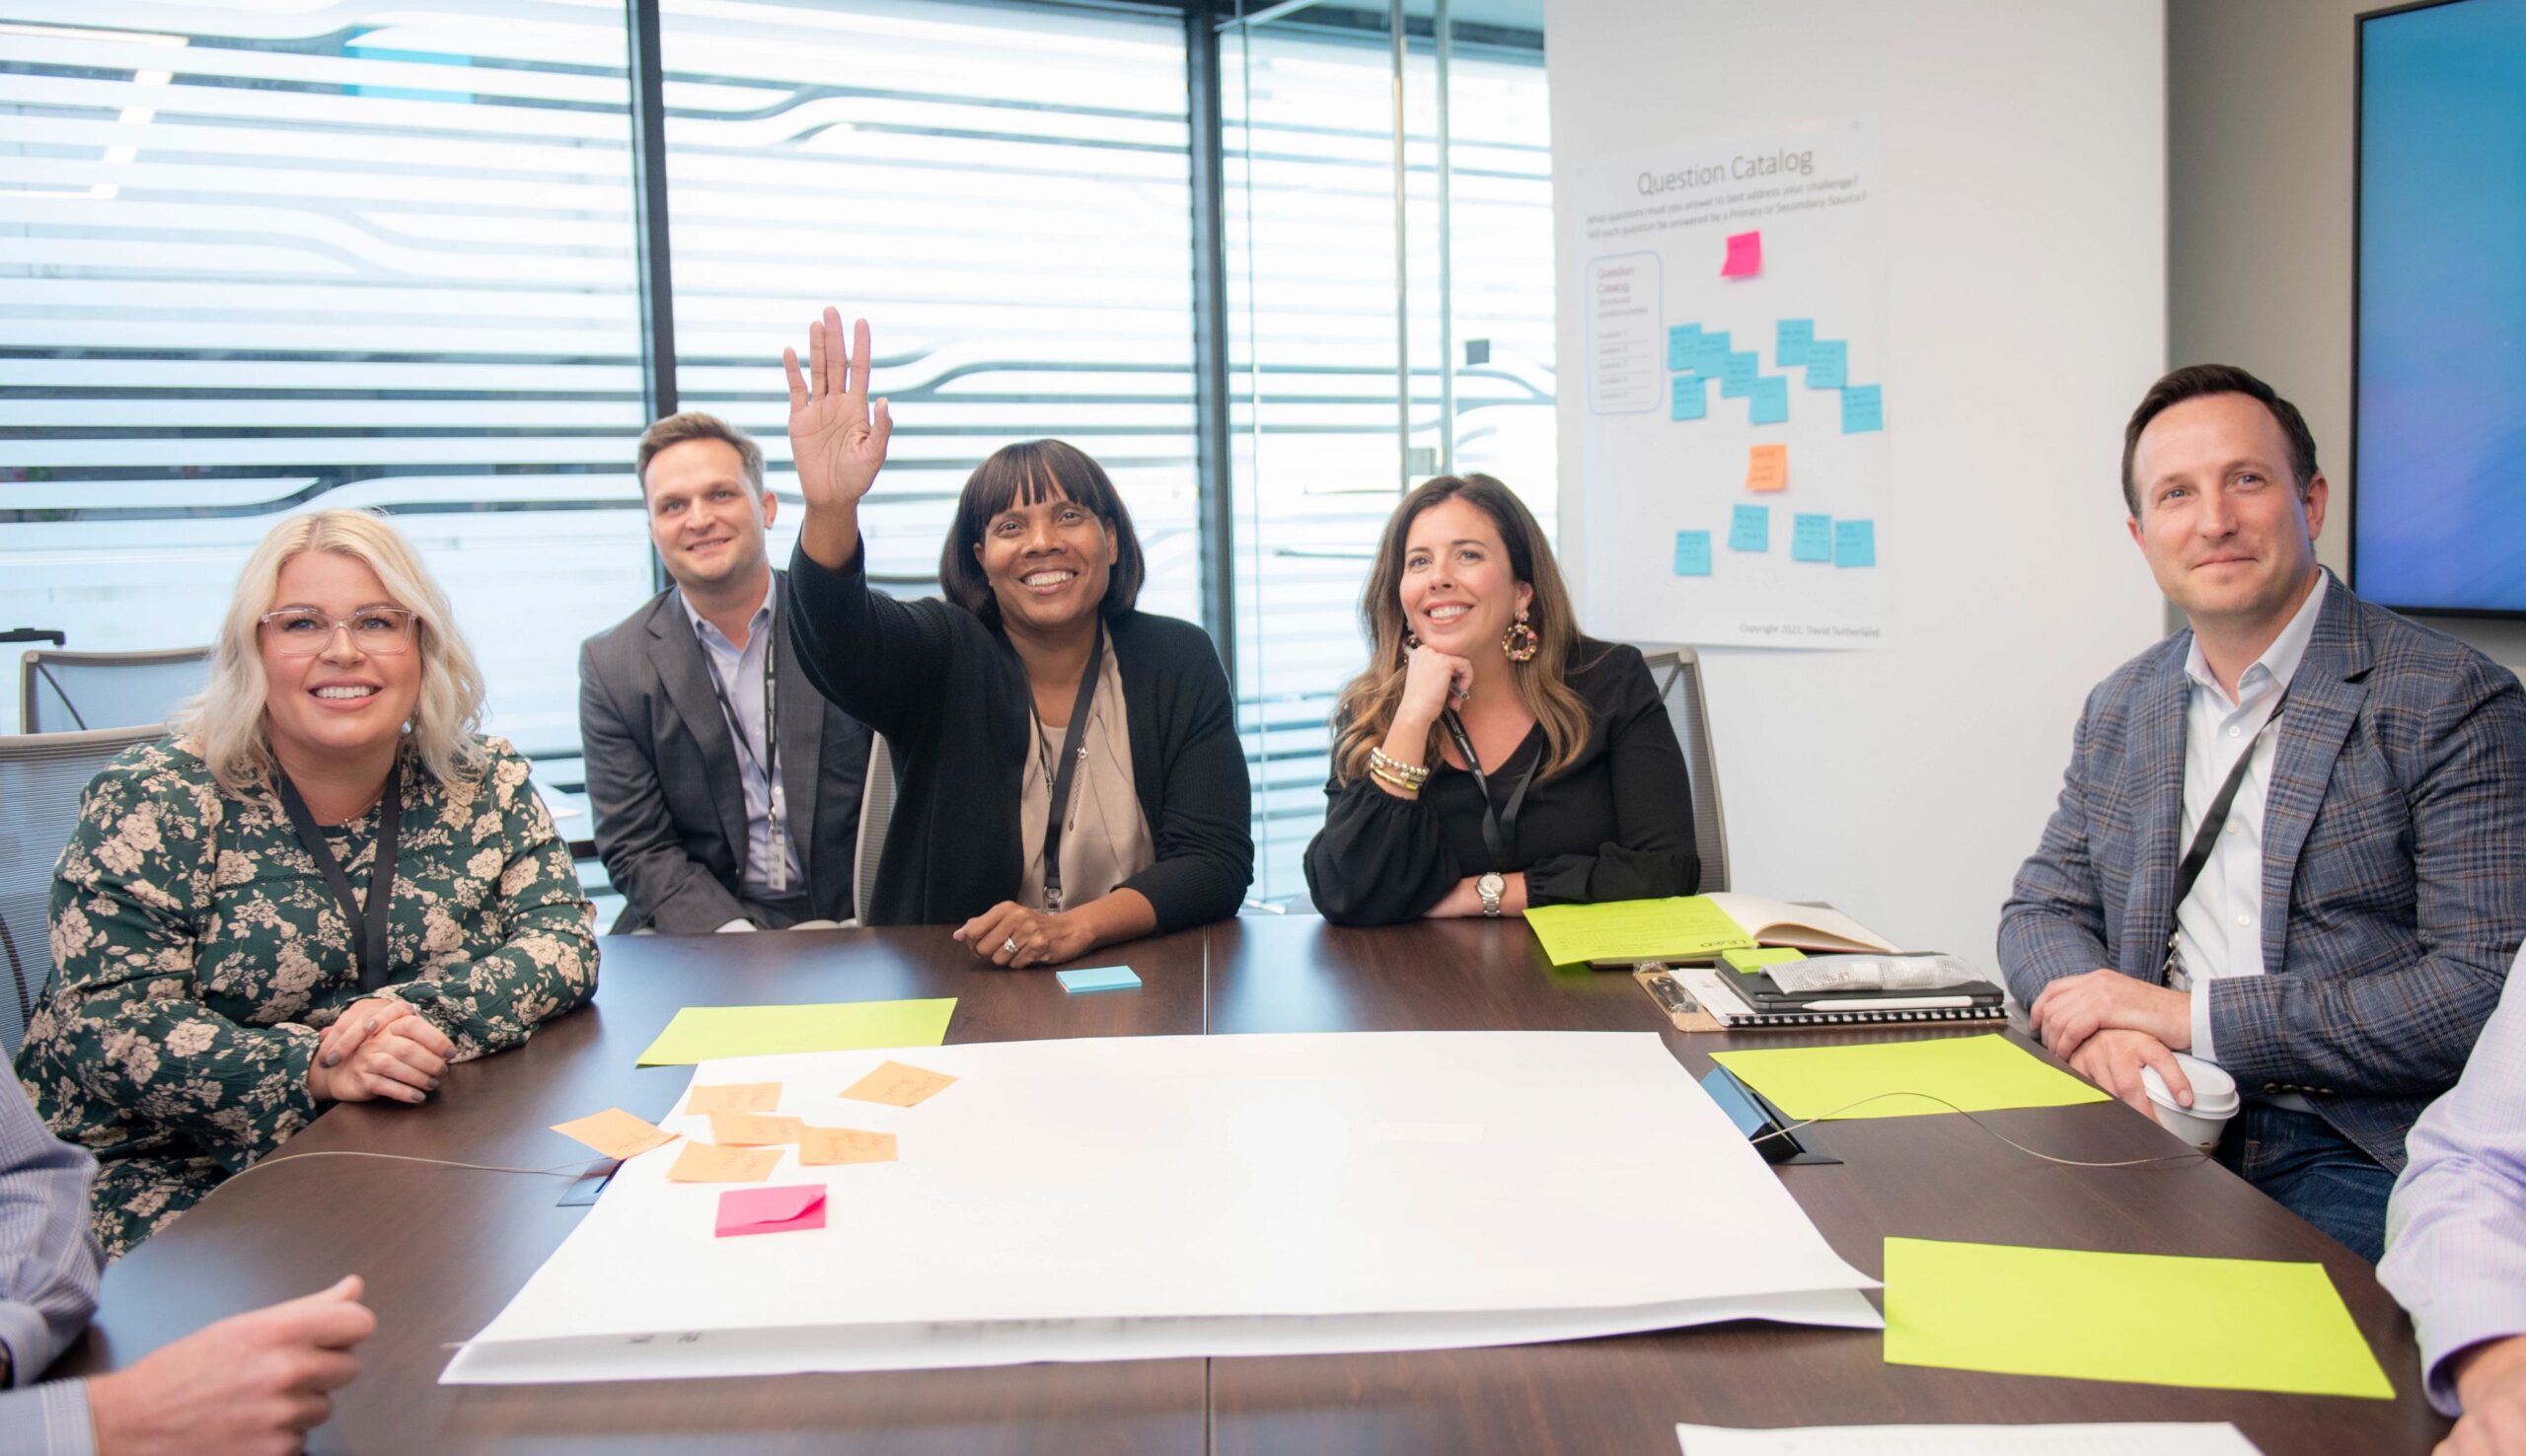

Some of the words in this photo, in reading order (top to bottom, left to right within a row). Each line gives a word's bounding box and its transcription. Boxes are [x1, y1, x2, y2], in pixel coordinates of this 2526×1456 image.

[1638, 163, 1725, 195] Question
[1731, 148, 1815, 180] Catalog
[1606, 207, 1643, 224] questions
[1645, 204, 1666, 217] must
[1667, 201, 1682, 214] you
[1684, 197, 1714, 211] answer
[1715, 196, 1726, 207] to
[1746, 187, 1781, 201] address
[1782, 183, 1805, 198] your
[1806, 173, 1860, 194] challenge?
[1623, 221, 1656, 237] question
[1670, 212, 1709, 228] answered
[1710, 211, 1721, 225] by
[1729, 206, 1763, 222] Primary
[1764, 204, 1774, 214] or
[1775, 197, 1826, 214] Secondary
[1827, 187, 1869, 206] Source?
[1597, 266, 1635, 280] Question
[1597, 282, 1630, 295] Catalog
[1740, 622, 1779, 636] Copyright
[1806, 623, 1832, 637] David
